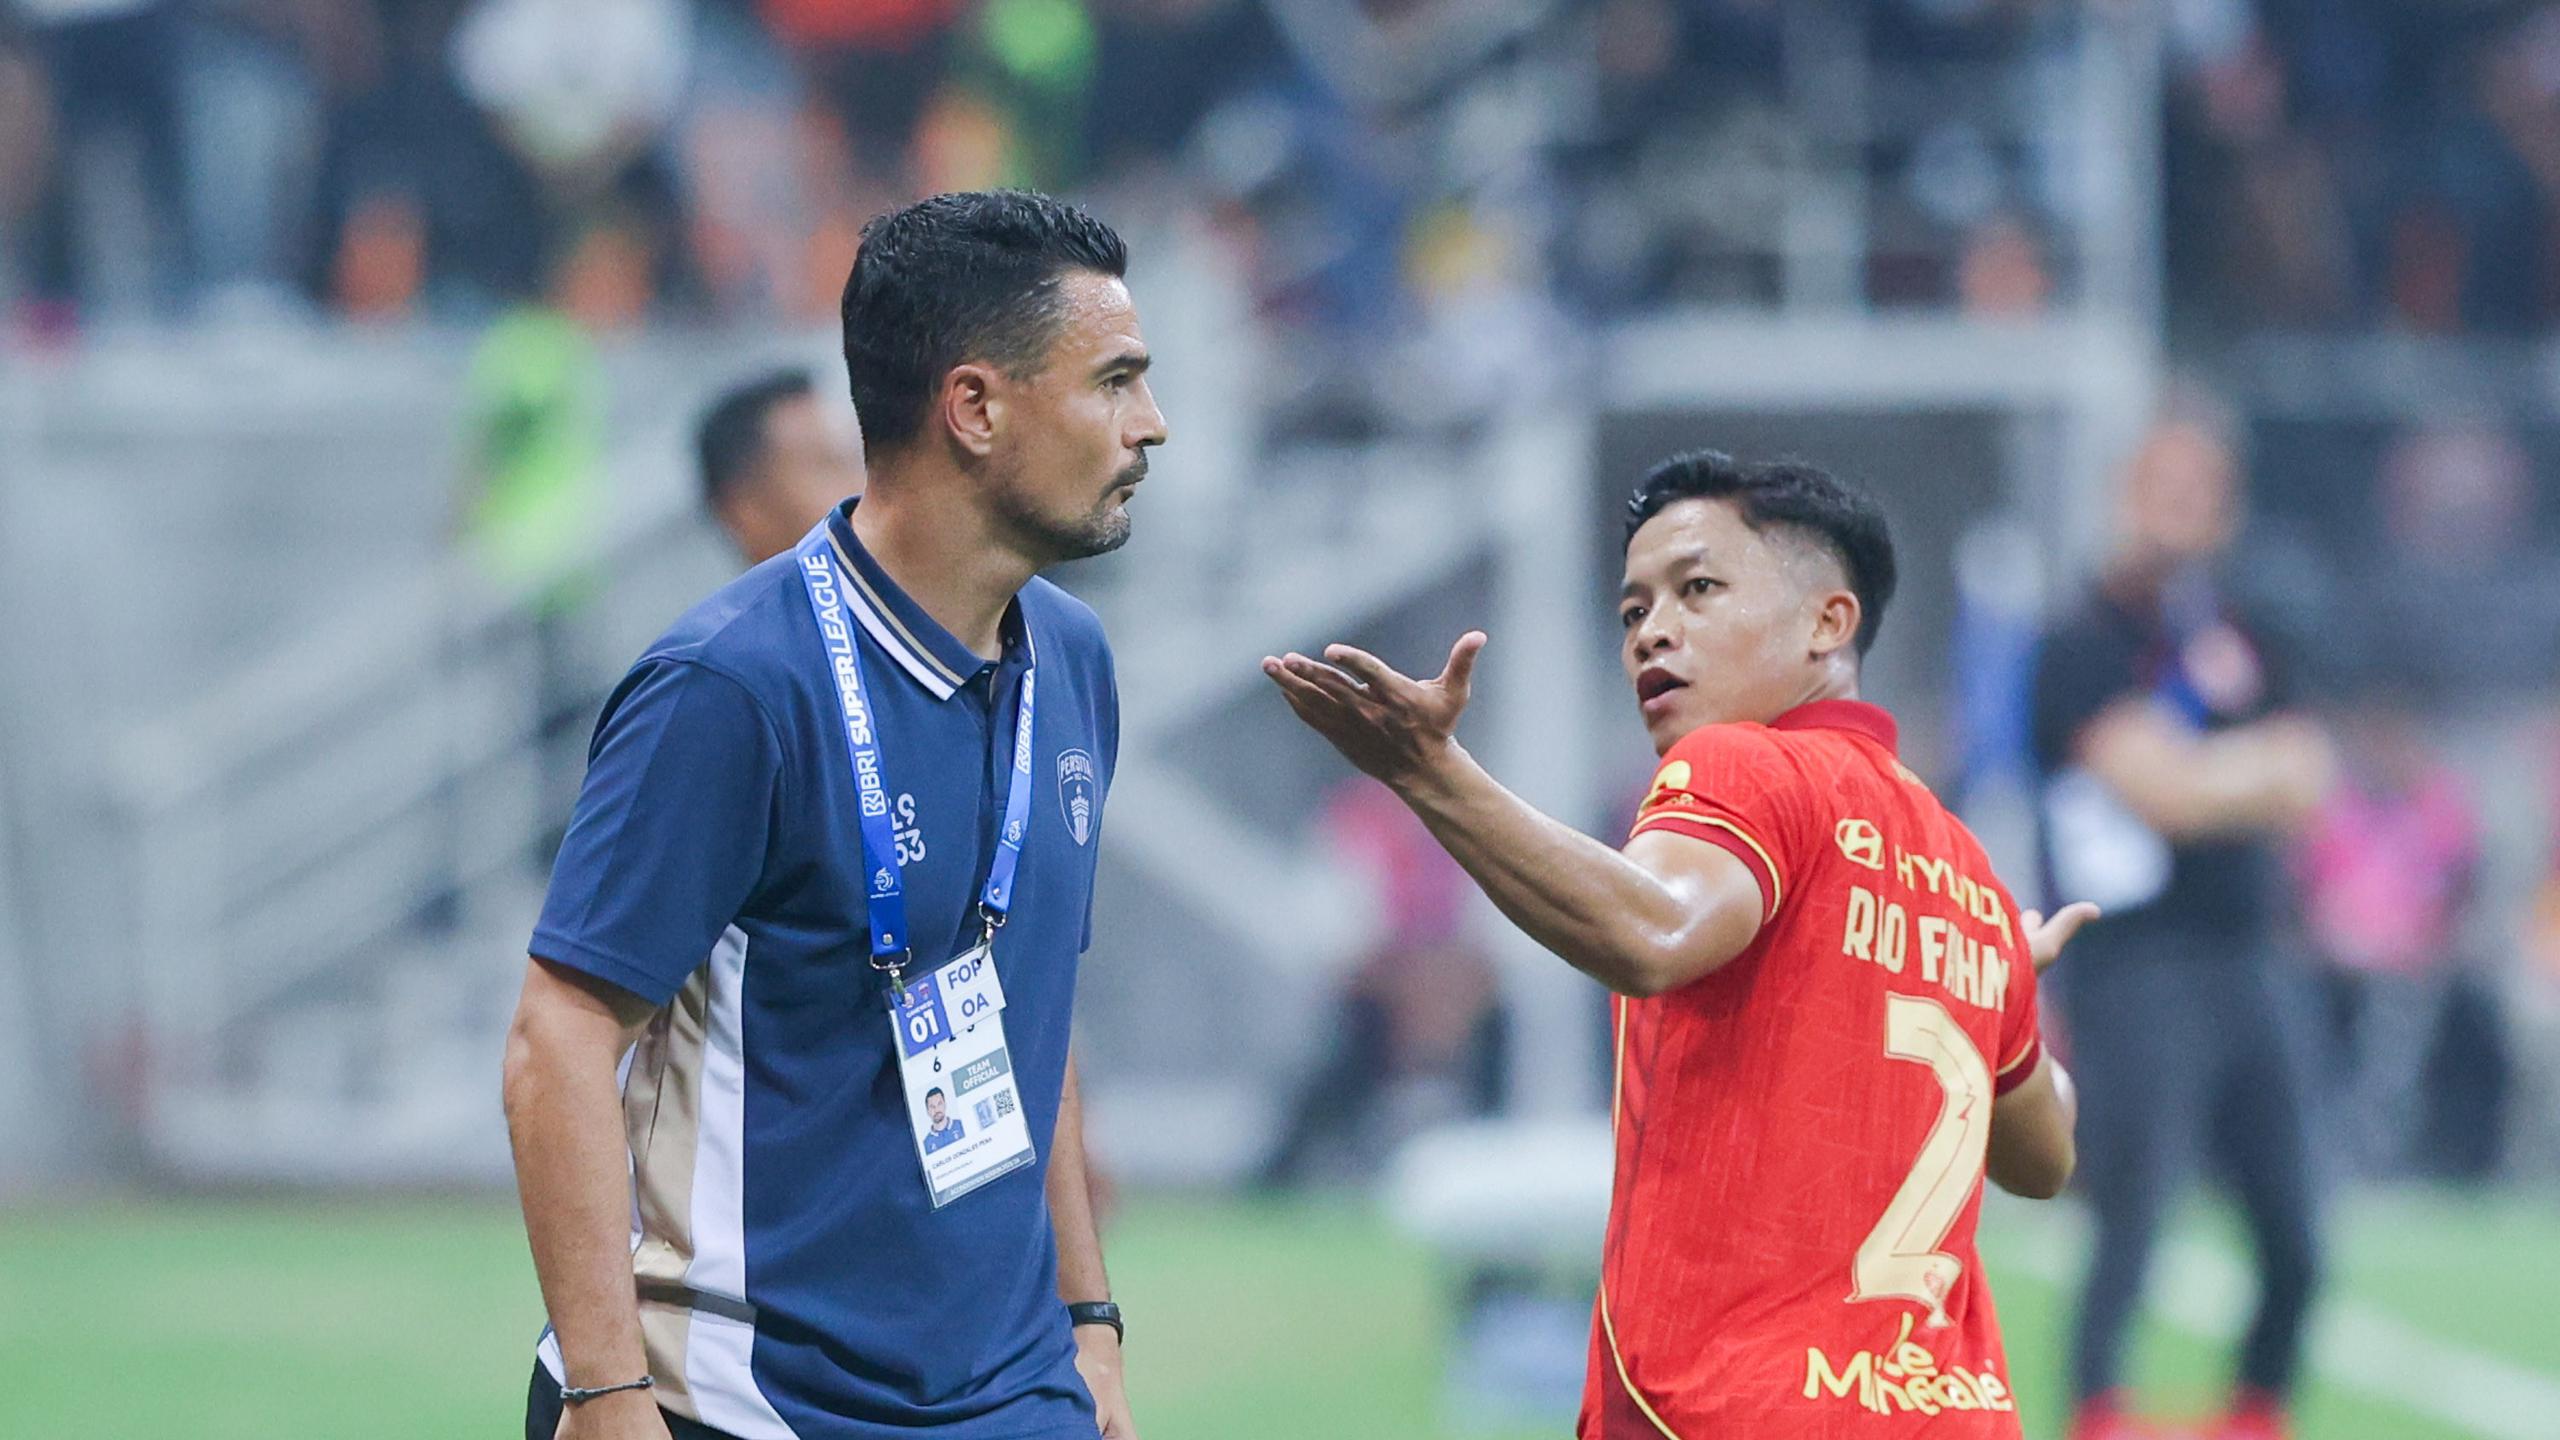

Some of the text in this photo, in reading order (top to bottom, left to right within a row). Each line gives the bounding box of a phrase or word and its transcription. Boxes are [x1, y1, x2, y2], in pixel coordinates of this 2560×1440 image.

[855, 750, 881, 790] BRI
[1842, 885, 1907, 974] RIO
[947, 958, 982, 990] FOP
[961, 992, 990, 1018] OA
[909, 1008, 939, 1044] 01
[933, 1056, 942, 1073] 6
[962, 1066, 1000, 1090] OFFICIAL
[967, 1058, 991, 1076] TEAM
[1844, 991, 1992, 1327] 2
[1883, 1311, 1938, 1377] Le
